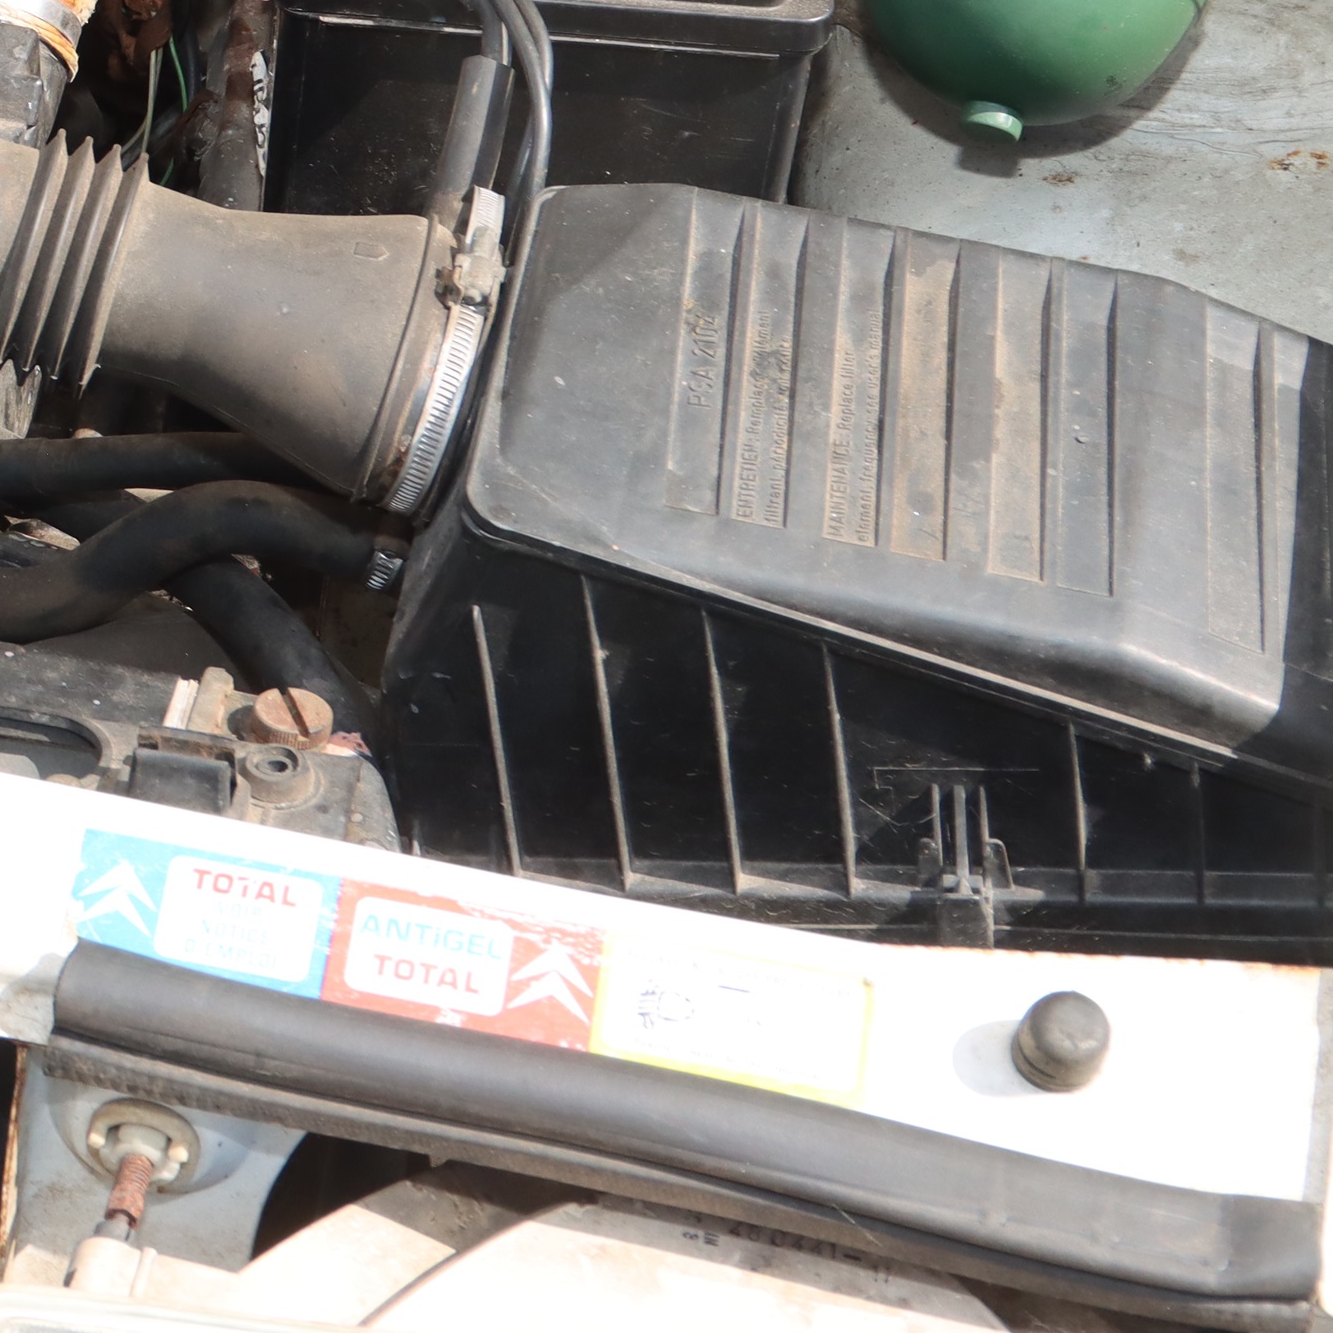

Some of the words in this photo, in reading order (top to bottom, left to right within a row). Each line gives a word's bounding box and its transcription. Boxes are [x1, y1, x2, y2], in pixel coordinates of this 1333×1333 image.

[687, 364, 716, 410] PSA
[192, 866, 298, 908] TOTAL
[371, 953, 483, 997] TOTAL
